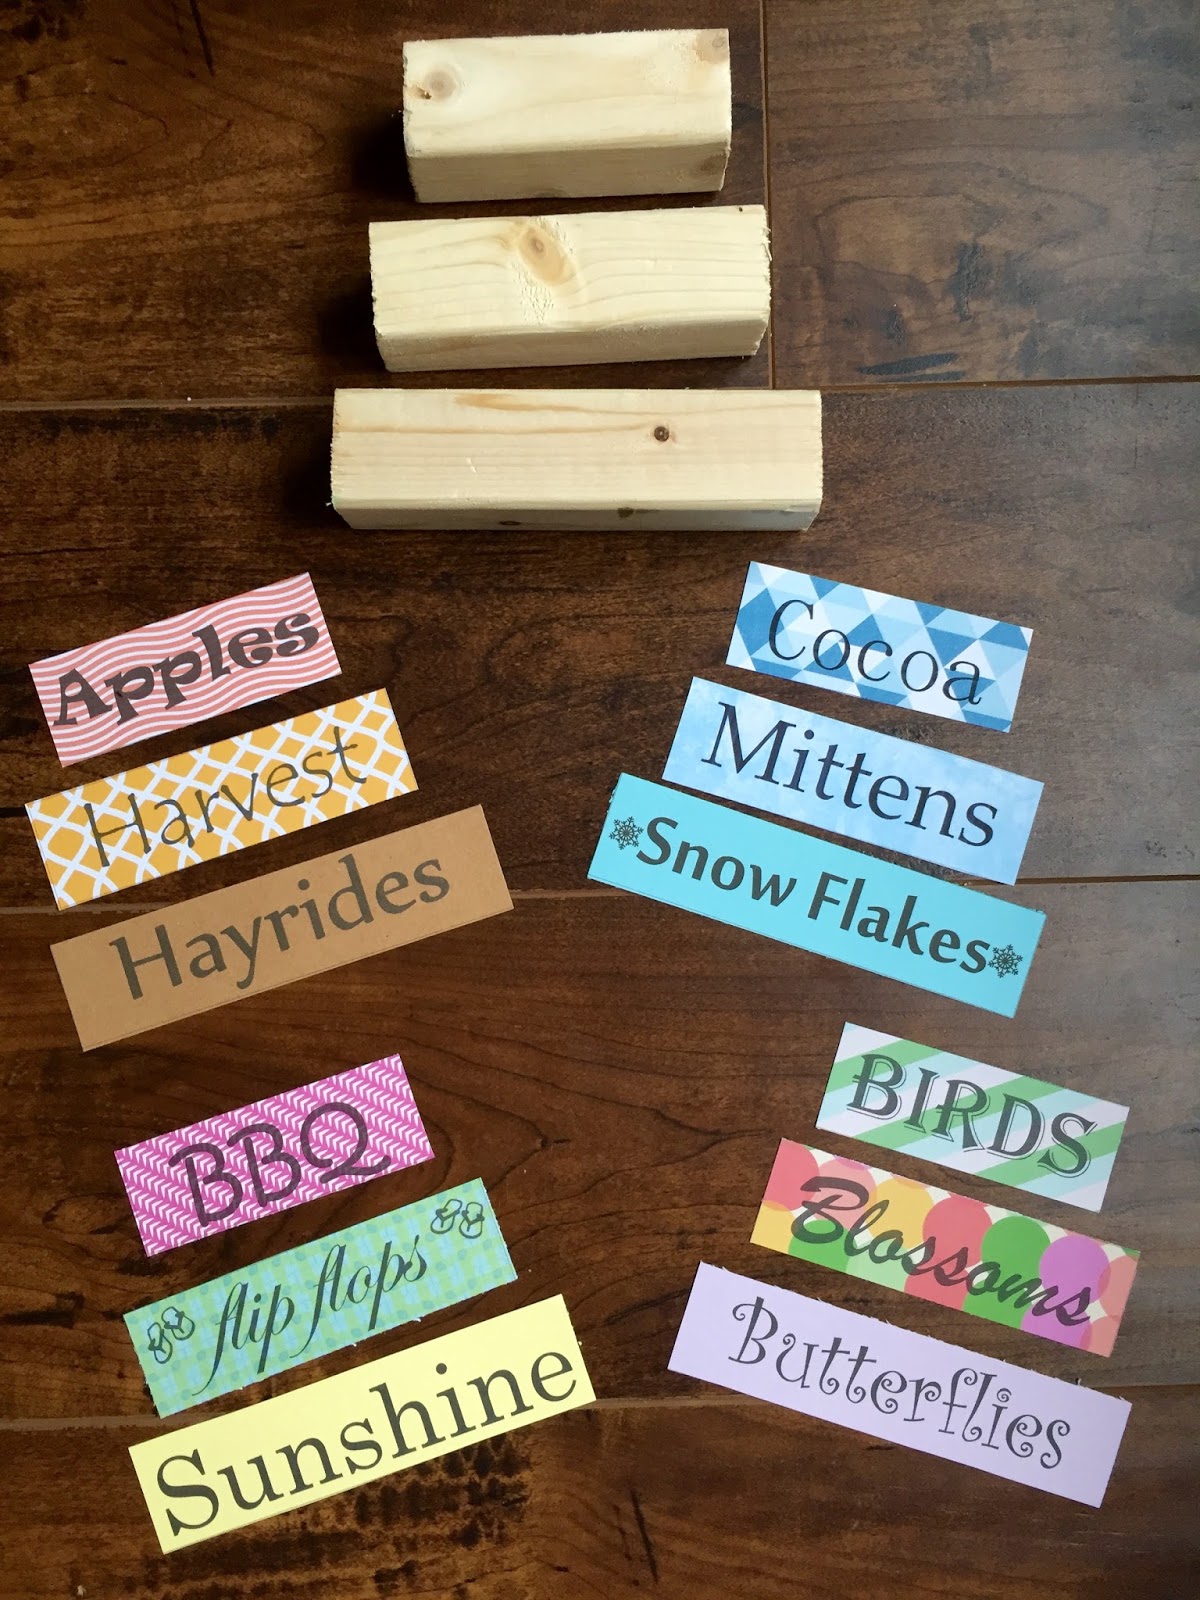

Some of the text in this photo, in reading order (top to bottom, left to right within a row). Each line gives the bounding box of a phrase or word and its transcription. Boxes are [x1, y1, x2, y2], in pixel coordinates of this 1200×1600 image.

[53, 612, 320, 726] Apples
[768, 599, 983, 706] Cocoa
[83, 726, 367, 867] Harvest
[701, 701, 998, 847] Mittens
[110, 854, 450, 1000] Hayrides
[635, 816, 991, 974] Snow Flakes
[168, 1101, 391, 1228] BBQ
[846, 1053, 1096, 1178] BIRDS
[192, 1234, 427, 1396] flip flops
[790, 1176, 1090, 1326] Blossoms
[156, 1351, 577, 1537] Sunshine
[728, 1296, 1071, 1469] Butterflies
